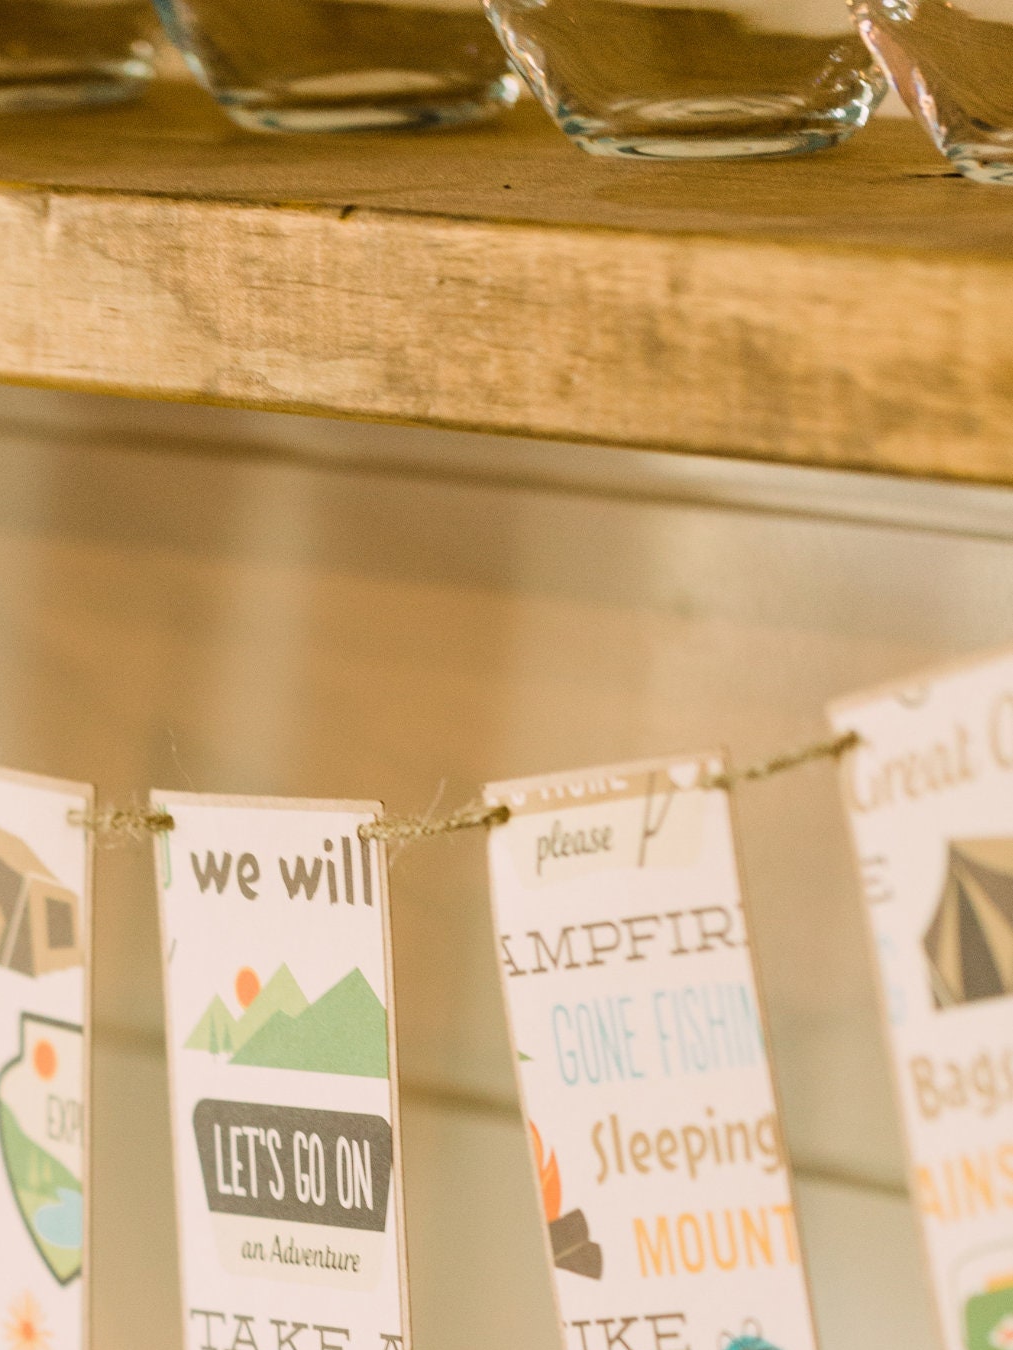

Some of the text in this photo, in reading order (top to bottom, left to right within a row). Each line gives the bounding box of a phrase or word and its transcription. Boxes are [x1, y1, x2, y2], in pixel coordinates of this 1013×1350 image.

[190, 836, 373, 906] we will
[537, 820, 614, 876] please
[500, 905, 748, 977] AMPFIR
[552, 997, 646, 1086] GONE
[213, 1123, 374, 1211] LET'S GO ON
[591, 1107, 786, 1186] Sleeping
[241, 1235, 361, 1273] an Adventure
[633, 1205, 797, 1278] MOUNT
